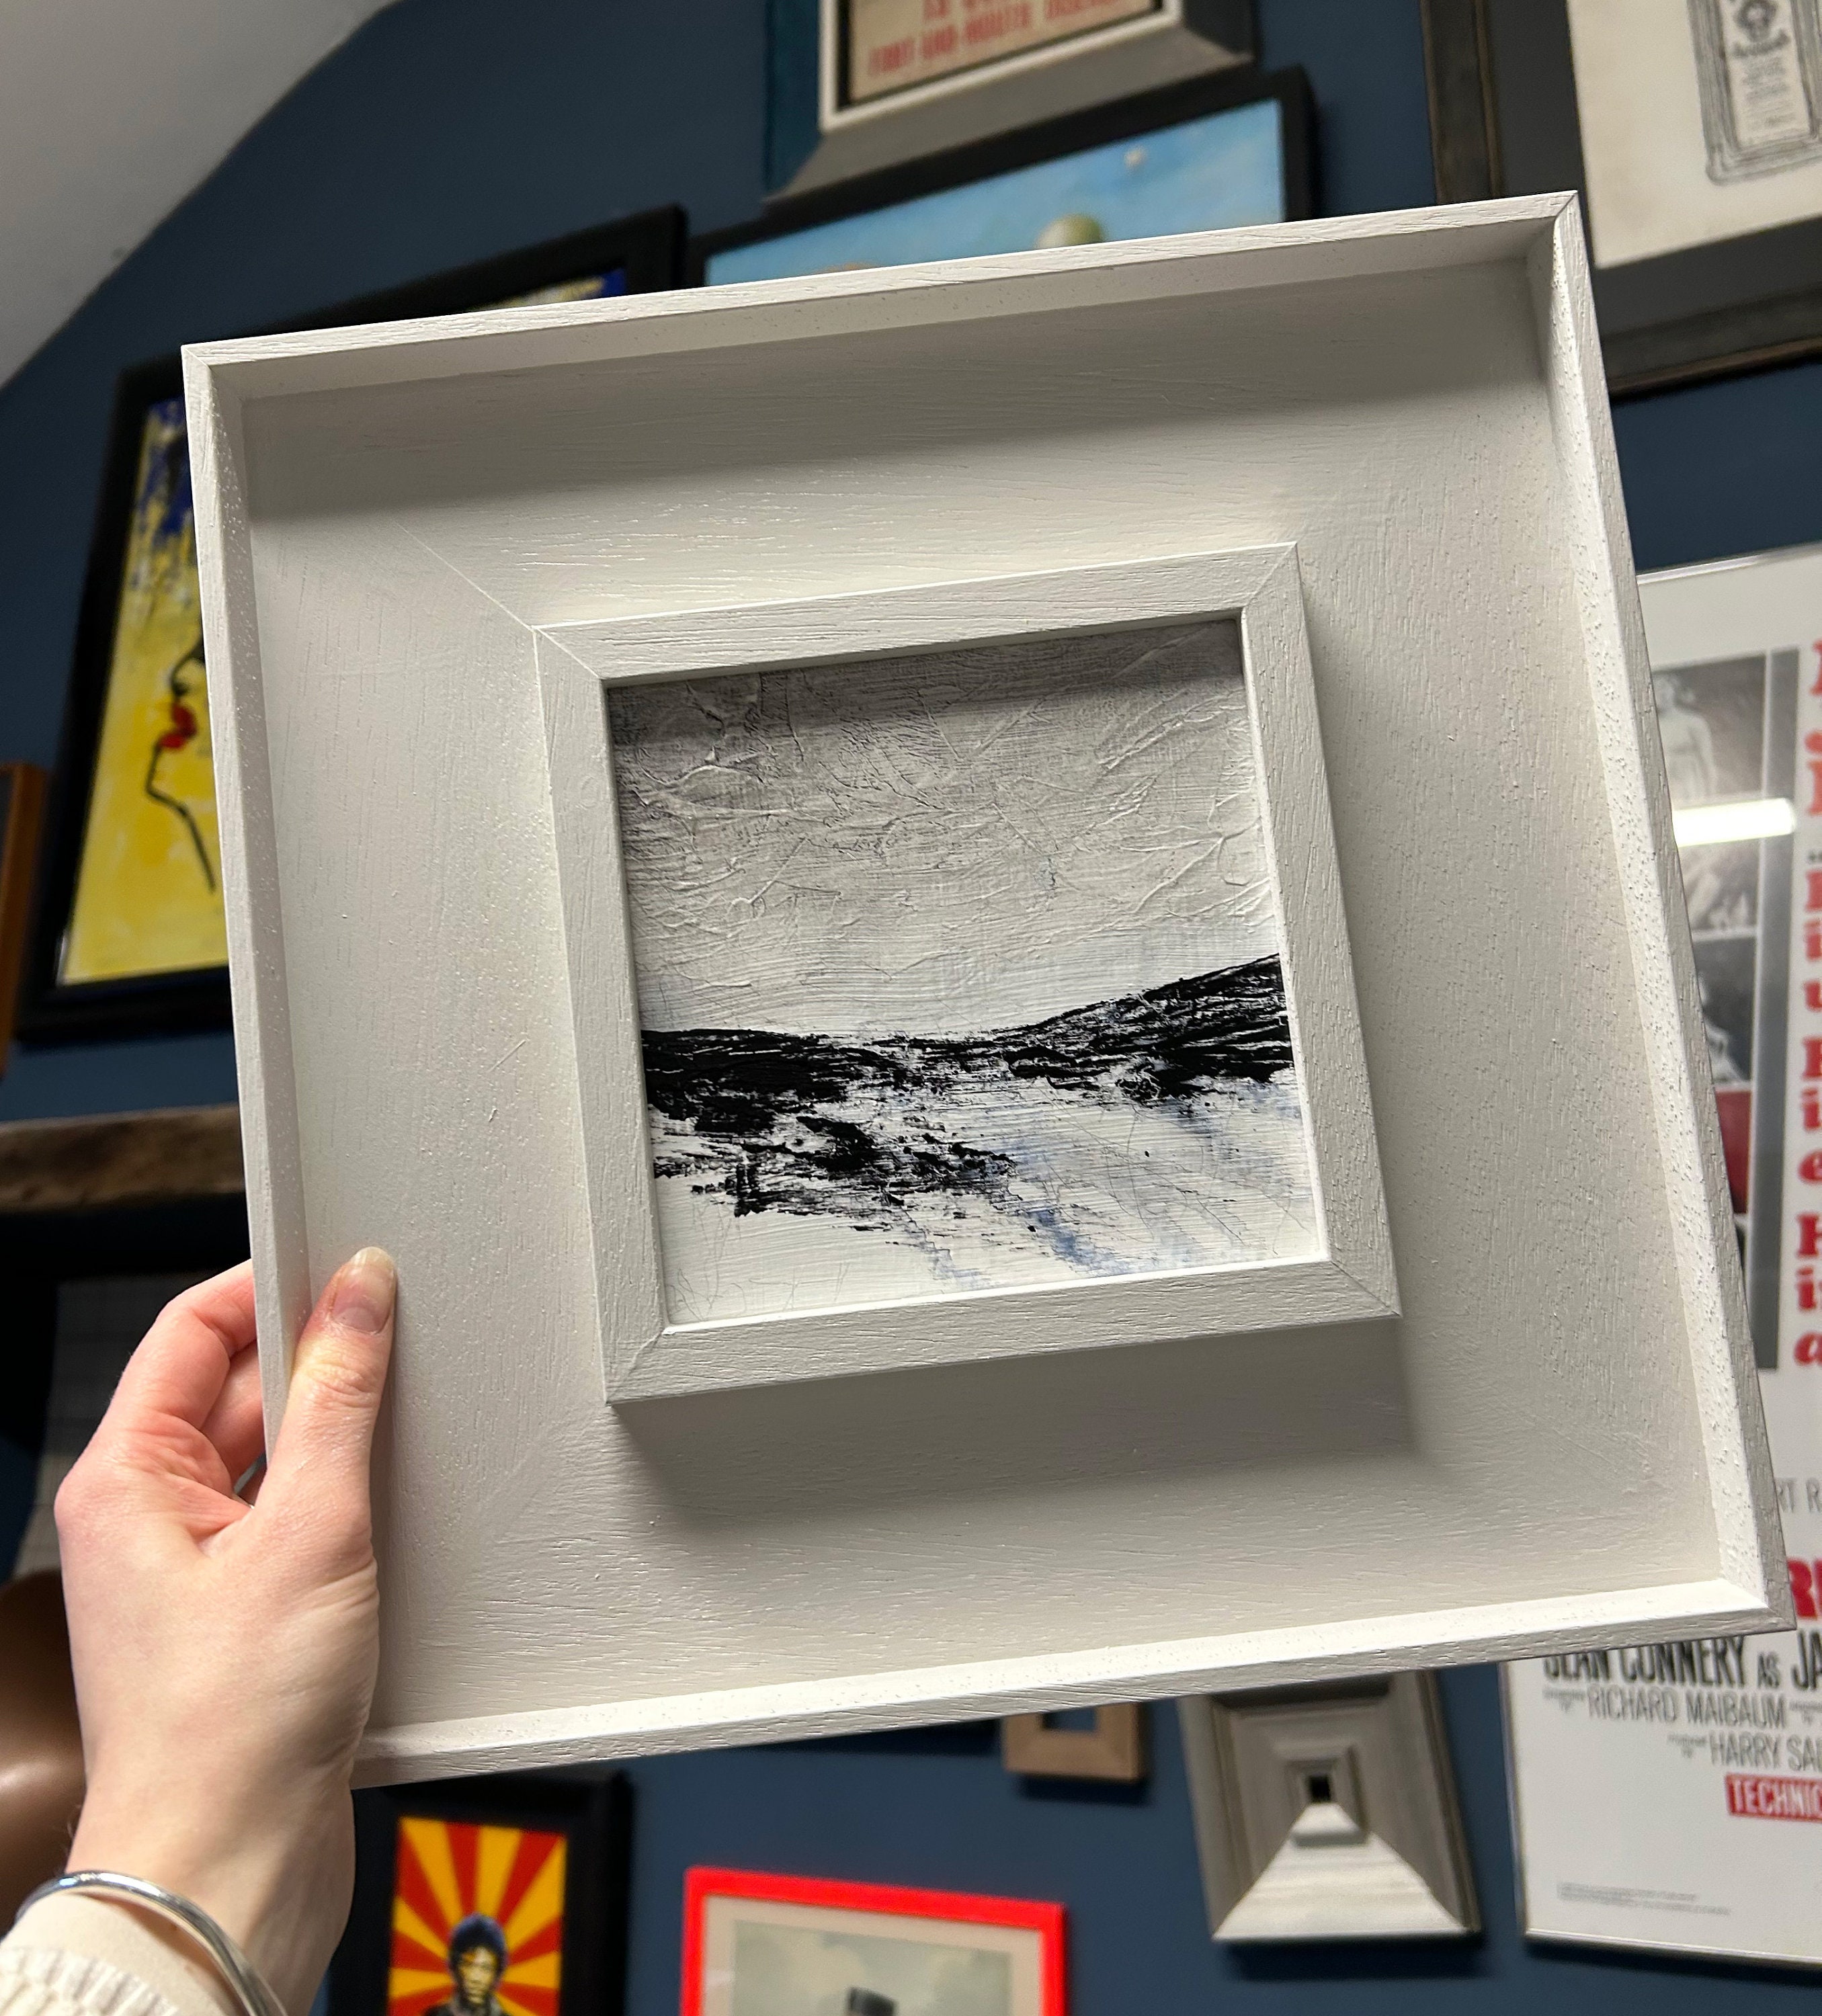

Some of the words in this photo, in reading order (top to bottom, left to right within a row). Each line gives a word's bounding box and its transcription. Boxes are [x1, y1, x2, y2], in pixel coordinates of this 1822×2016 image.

[1587, 1683, 1679, 1722] RICHARD
[1685, 1688, 1786, 1729] MAIBAUM
[1709, 1730, 1781, 1768] HARRY
